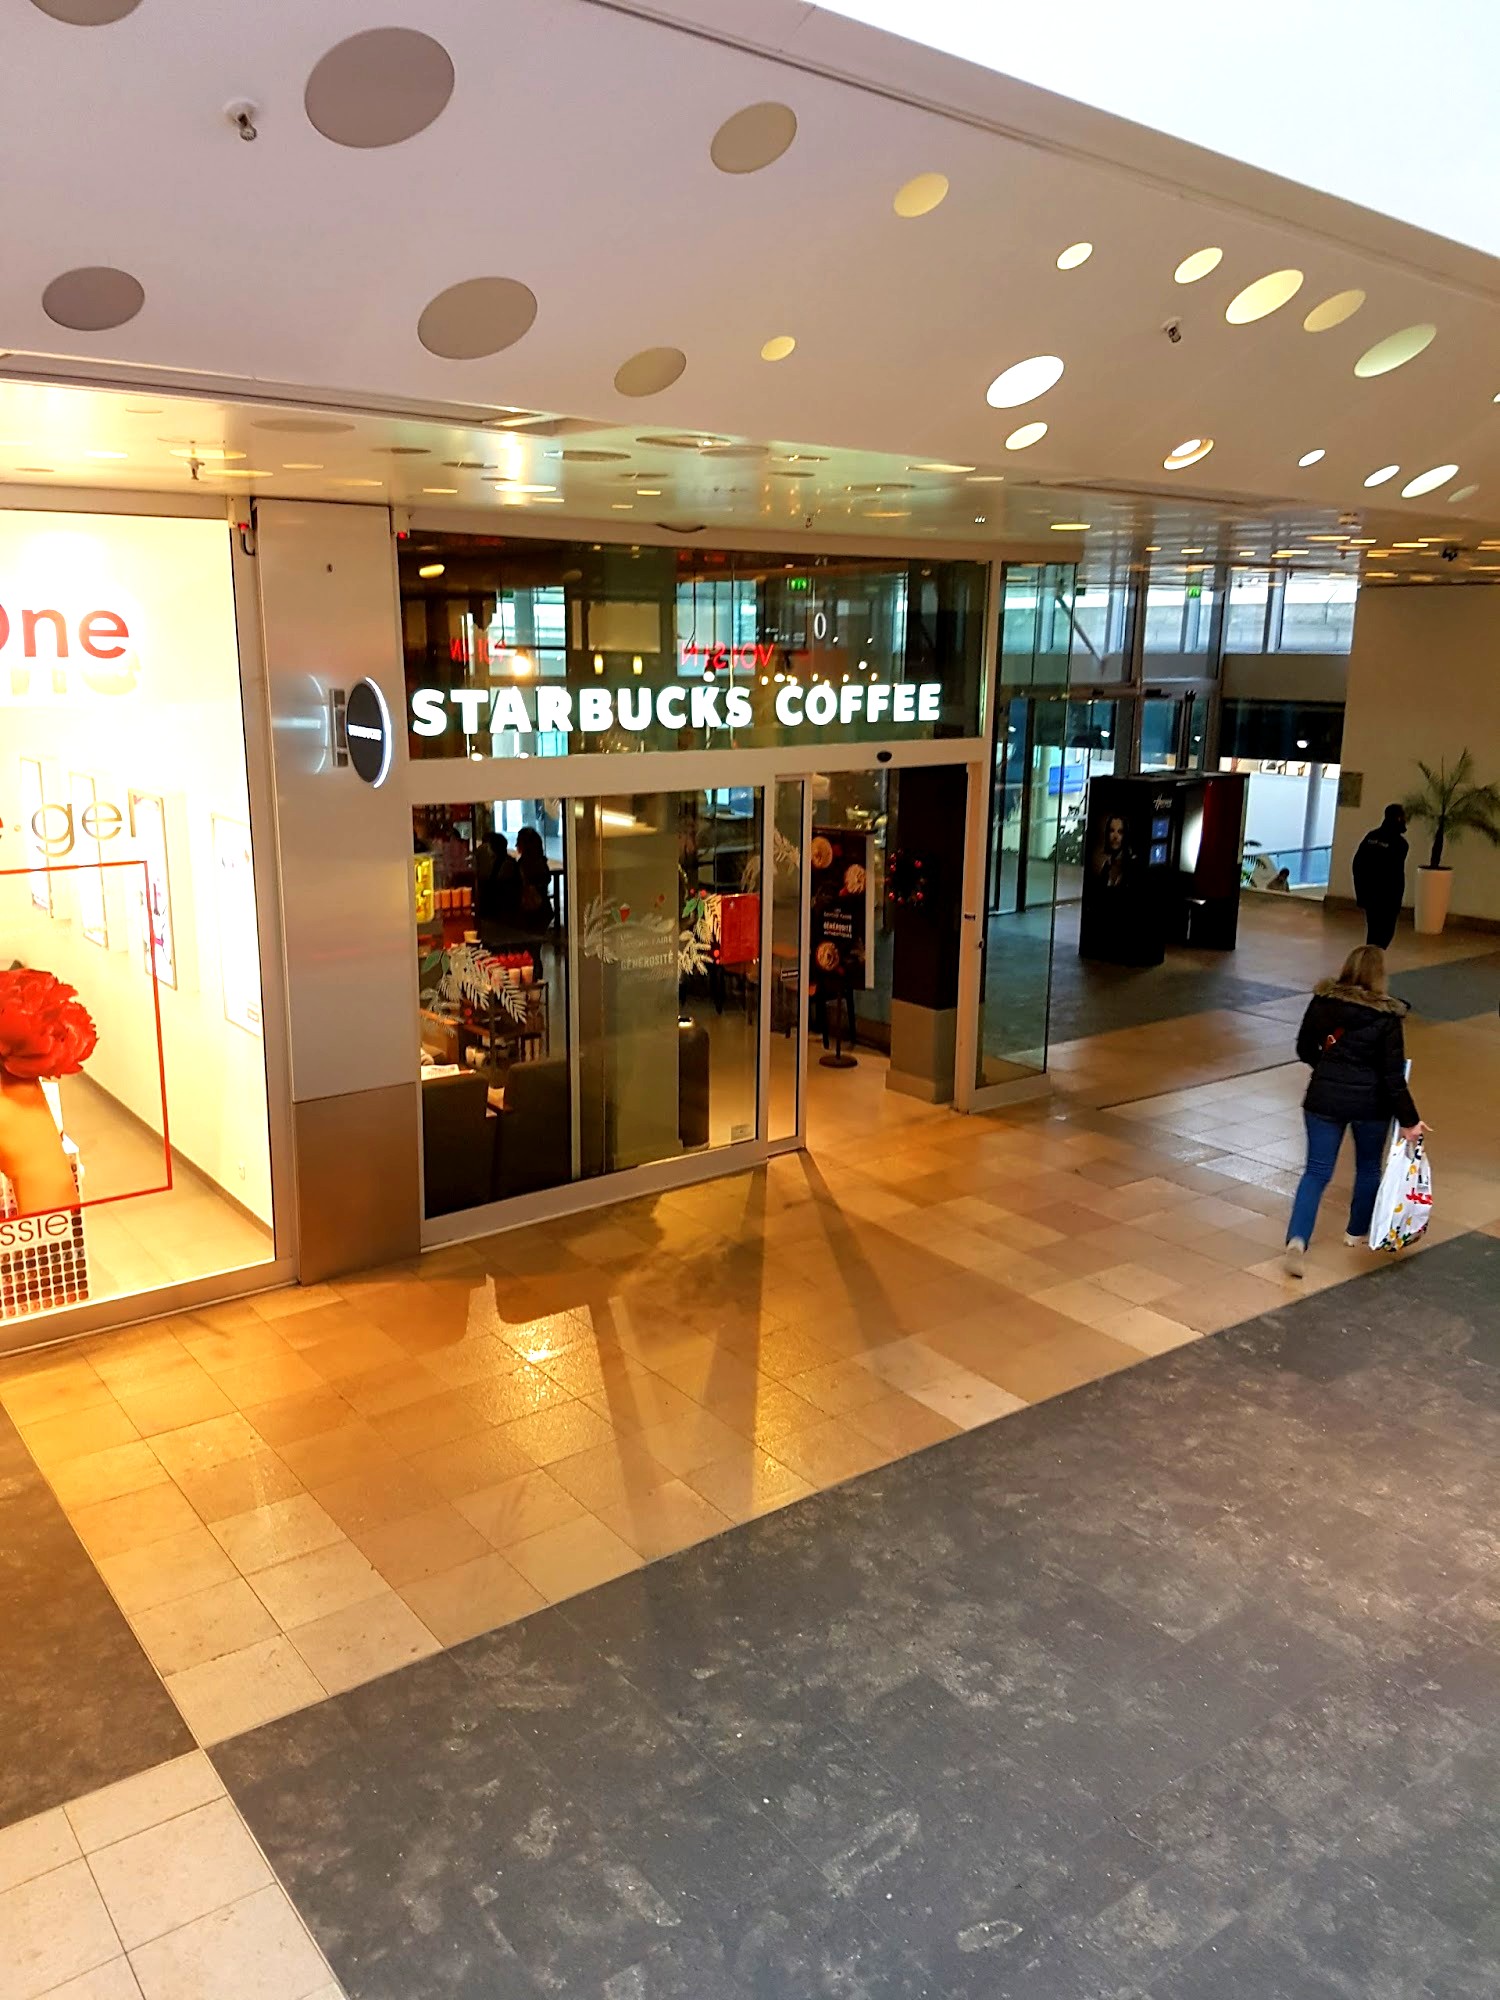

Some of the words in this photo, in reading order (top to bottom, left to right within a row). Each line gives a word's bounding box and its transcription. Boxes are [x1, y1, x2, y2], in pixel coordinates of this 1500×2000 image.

[0, 603, 129, 659] ne
[411, 686, 752, 736] STARBUCKS
[775, 684, 941, 726] COFFEE
